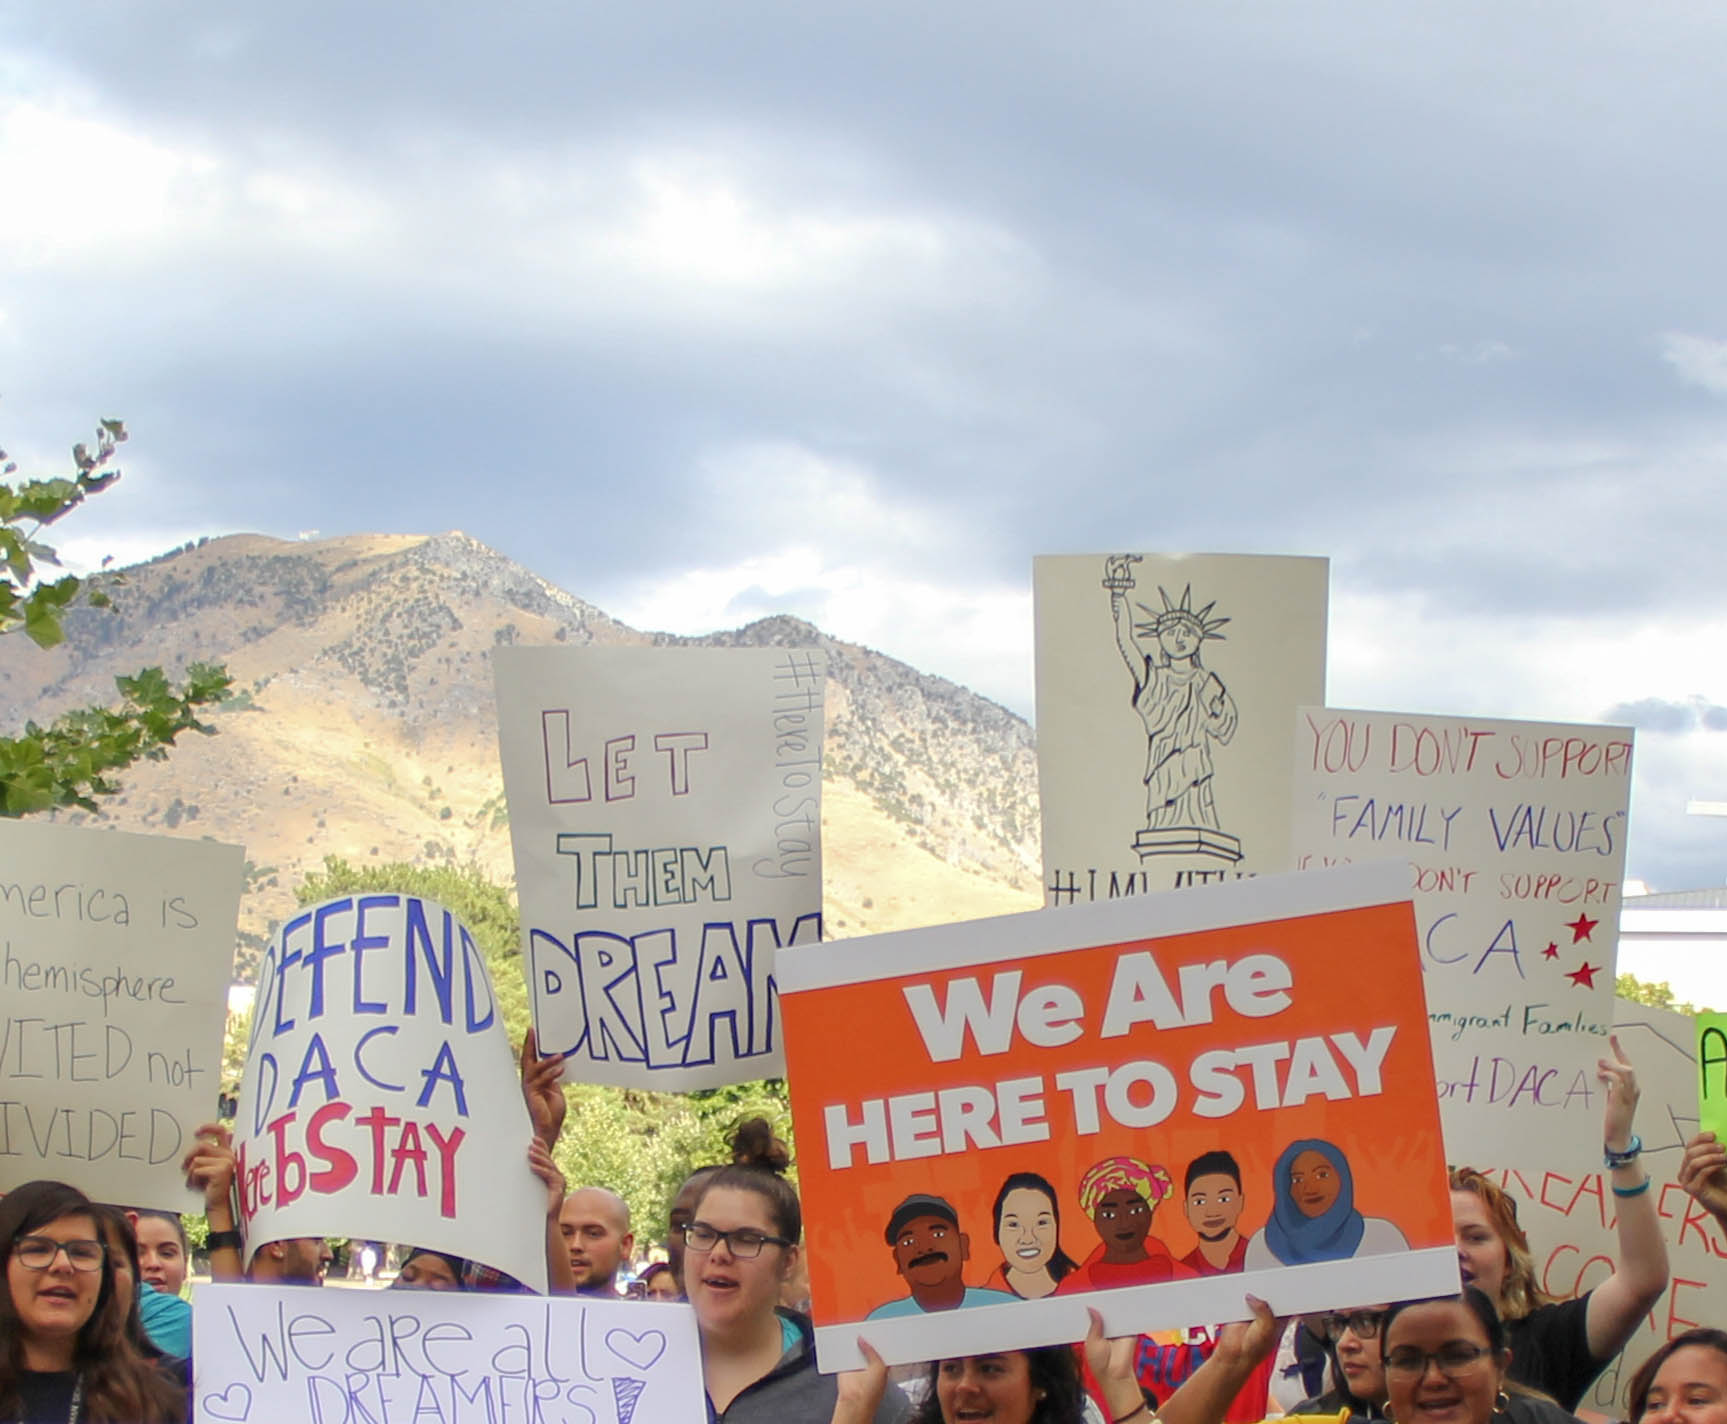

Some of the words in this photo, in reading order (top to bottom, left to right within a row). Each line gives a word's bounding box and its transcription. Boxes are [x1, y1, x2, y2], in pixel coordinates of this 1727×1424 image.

[542, 710, 709, 805] LET
[1305, 713, 1370, 773] YOU
[1389, 722, 1496, 776] DON'T
[1495, 735, 1633, 779] SUPPORT
[557, 833, 732, 909] THEM
[1499, 872, 1617, 904] SUPPORT
[162, 890, 198, 929] is
[4, 942, 187, 1018] hemisphere
[530, 912, 823, 1070] DREAM
[901, 970, 1085, 1064] We
[1100, 950, 1295, 1039] Are
[1428, 1005, 1511, 1041] mmigrant
[148, 1049, 205, 1090] not
[255, 1026, 470, 1139] DACA
[823, 1077, 1050, 1170] HERE
[1055, 1060, 1178, 1136] TO
[1189, 1025, 1398, 1119] STAY
[1488, 1056, 1594, 1109] DACA
[306, 1101, 467, 1219] STAY
[227, 1301, 336, 1384] We
[491, 1303, 605, 1383] all
